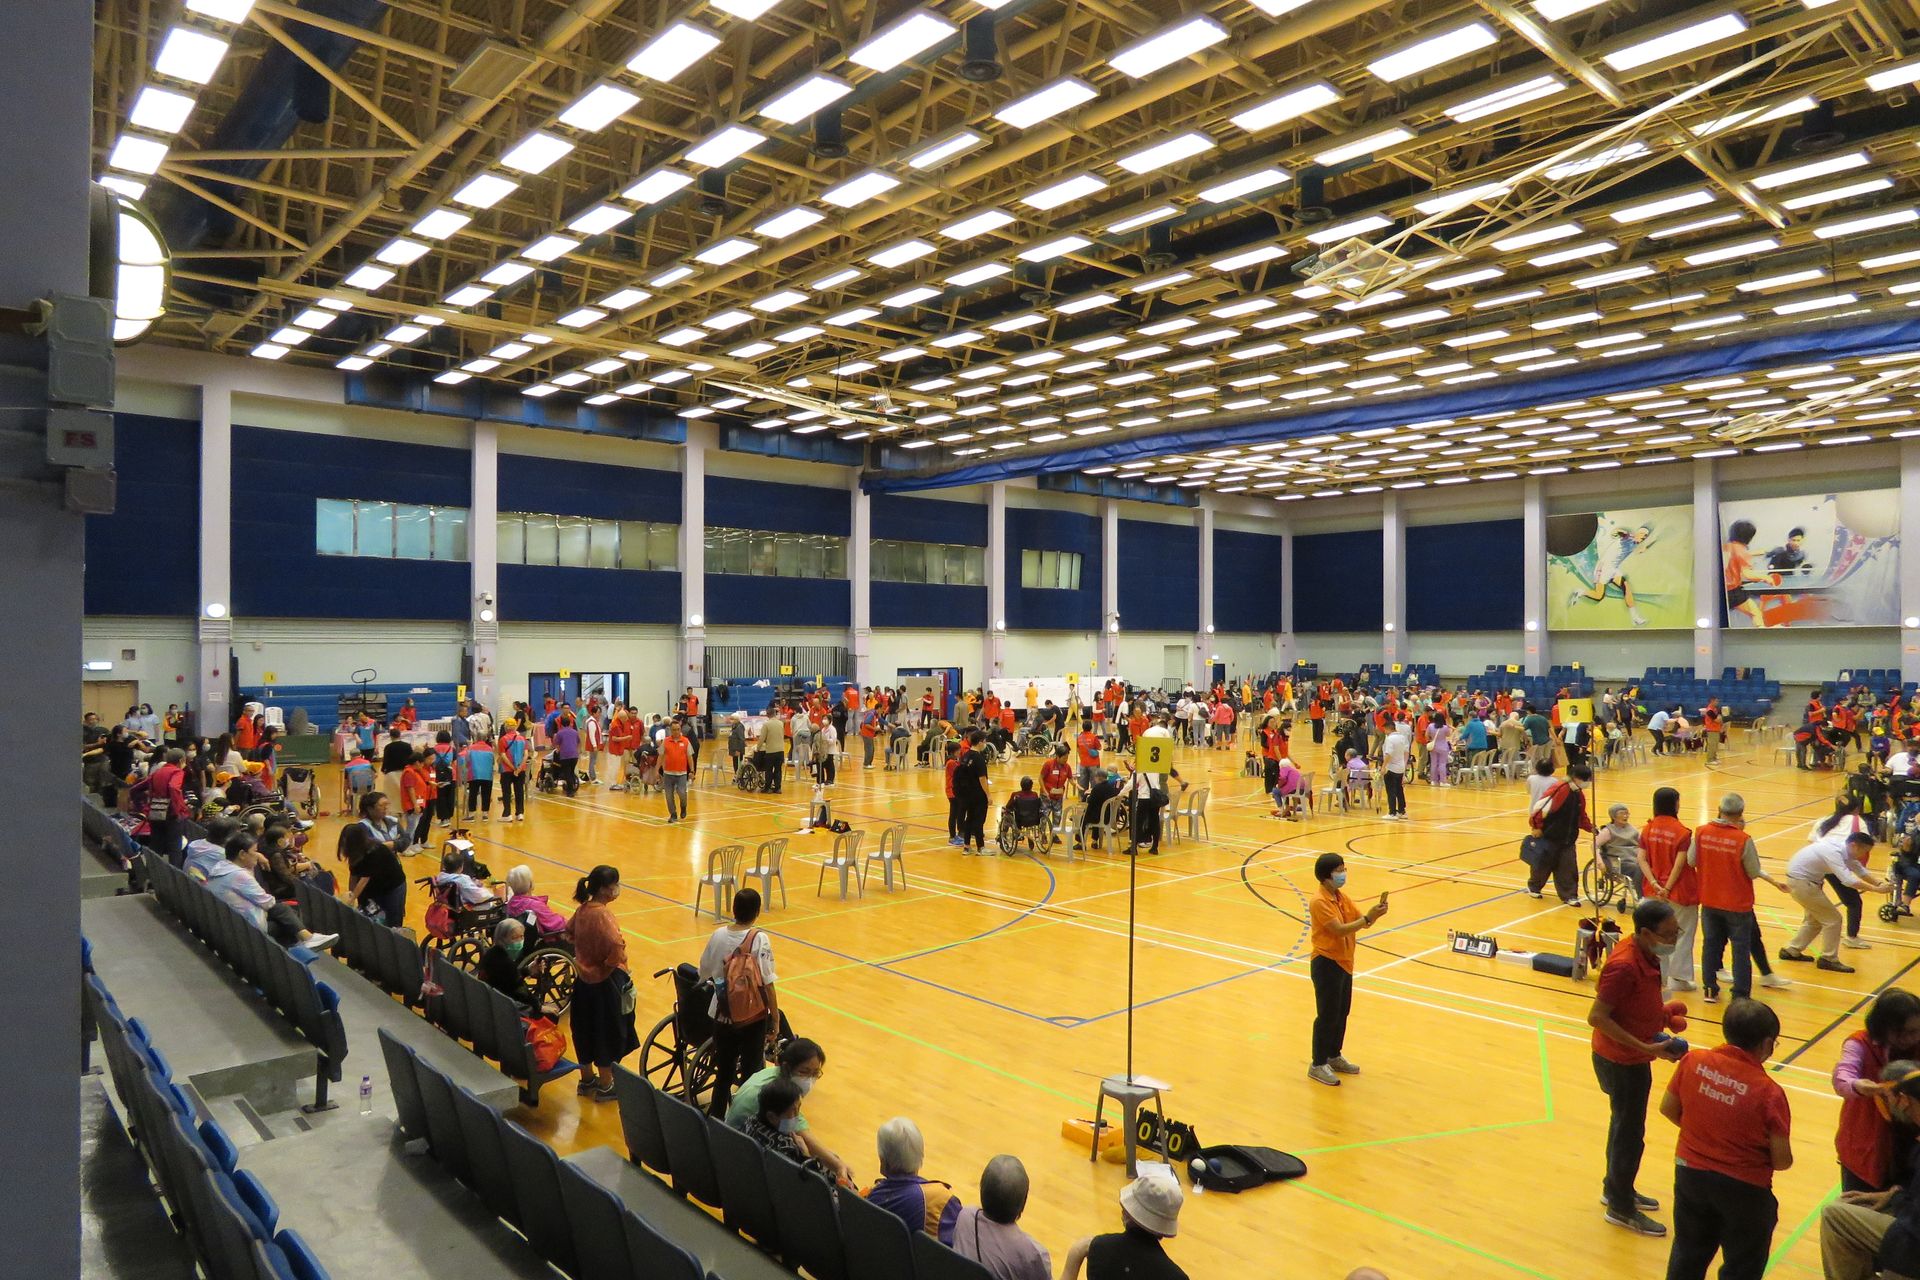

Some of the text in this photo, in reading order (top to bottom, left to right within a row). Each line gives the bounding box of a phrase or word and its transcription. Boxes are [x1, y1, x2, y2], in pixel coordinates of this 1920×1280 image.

[1570, 705, 1578, 716] 6
[1150, 746, 1160, 763] 3
[1696, 1063, 1748, 1096] Helping
[1699, 1081, 1735, 1106] Hand
[1138, 1122, 1151, 1140] 0
[1168, 1133, 1182, 1152] 0
